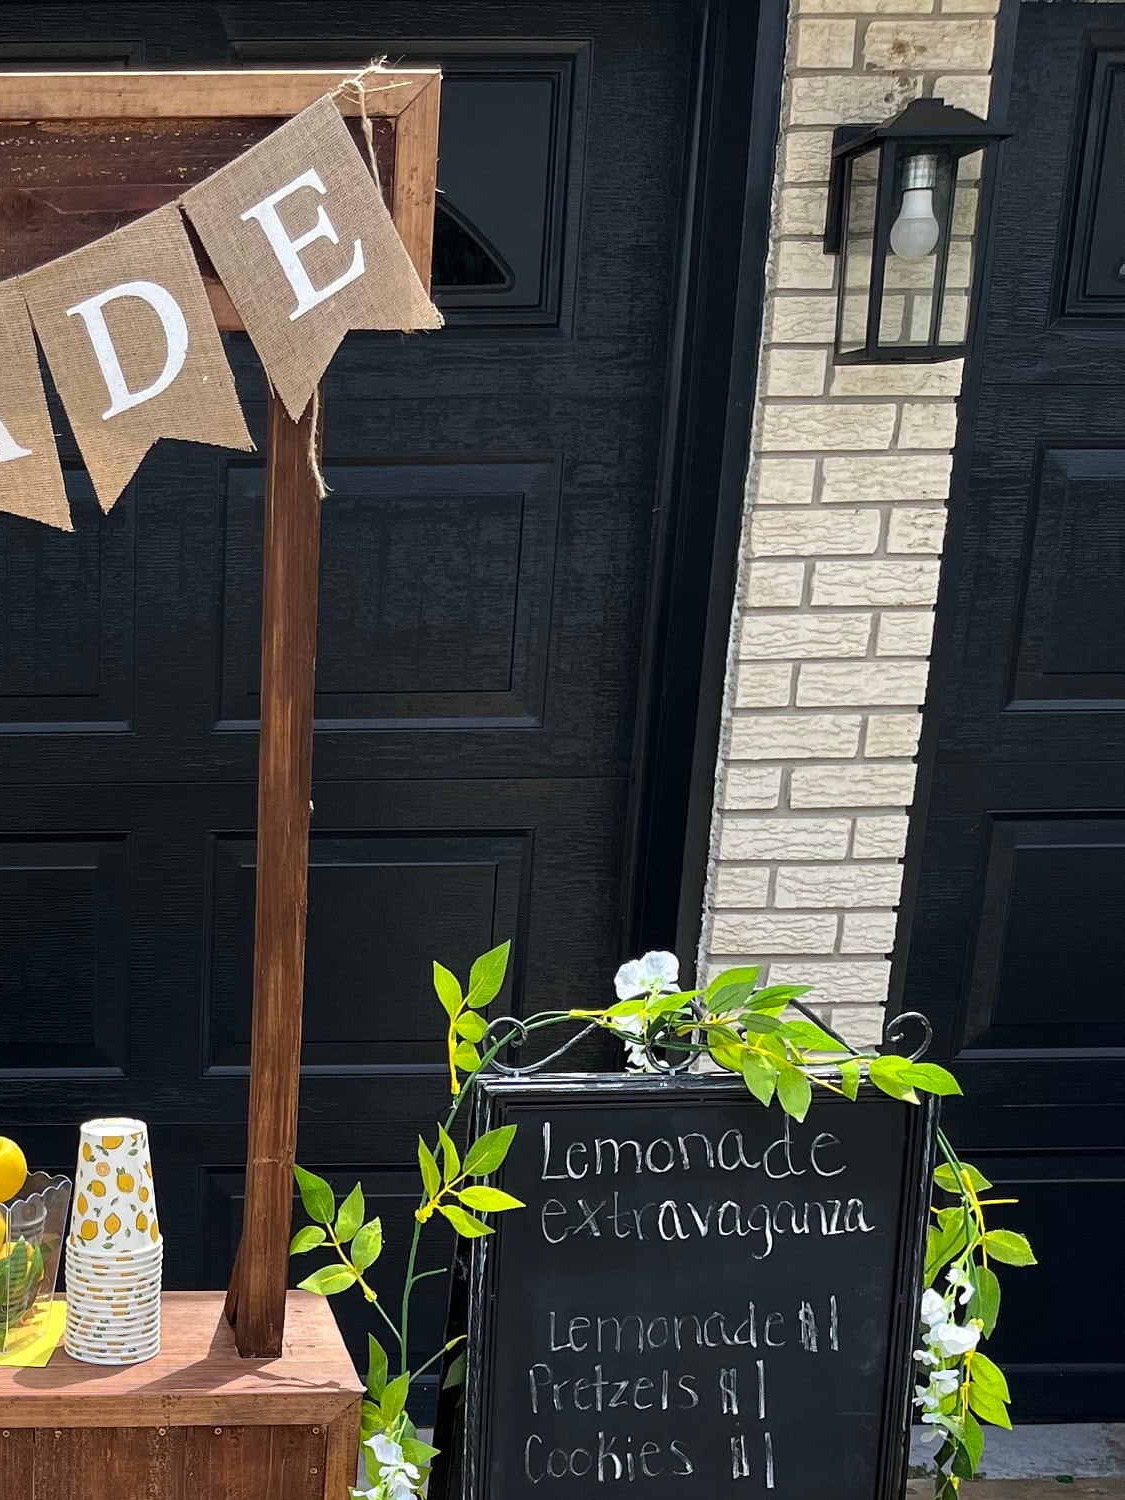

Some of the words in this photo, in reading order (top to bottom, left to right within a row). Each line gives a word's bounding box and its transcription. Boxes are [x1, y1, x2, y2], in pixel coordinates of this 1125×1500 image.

[540, 1114, 847, 1182] Lemonade
[540, 1190, 875, 1260] extravaganza
[548, 1300, 786, 1354] Lemonade
[528, 1362, 700, 1415] Pretzels
[524, 1430, 695, 1485] Cookies
